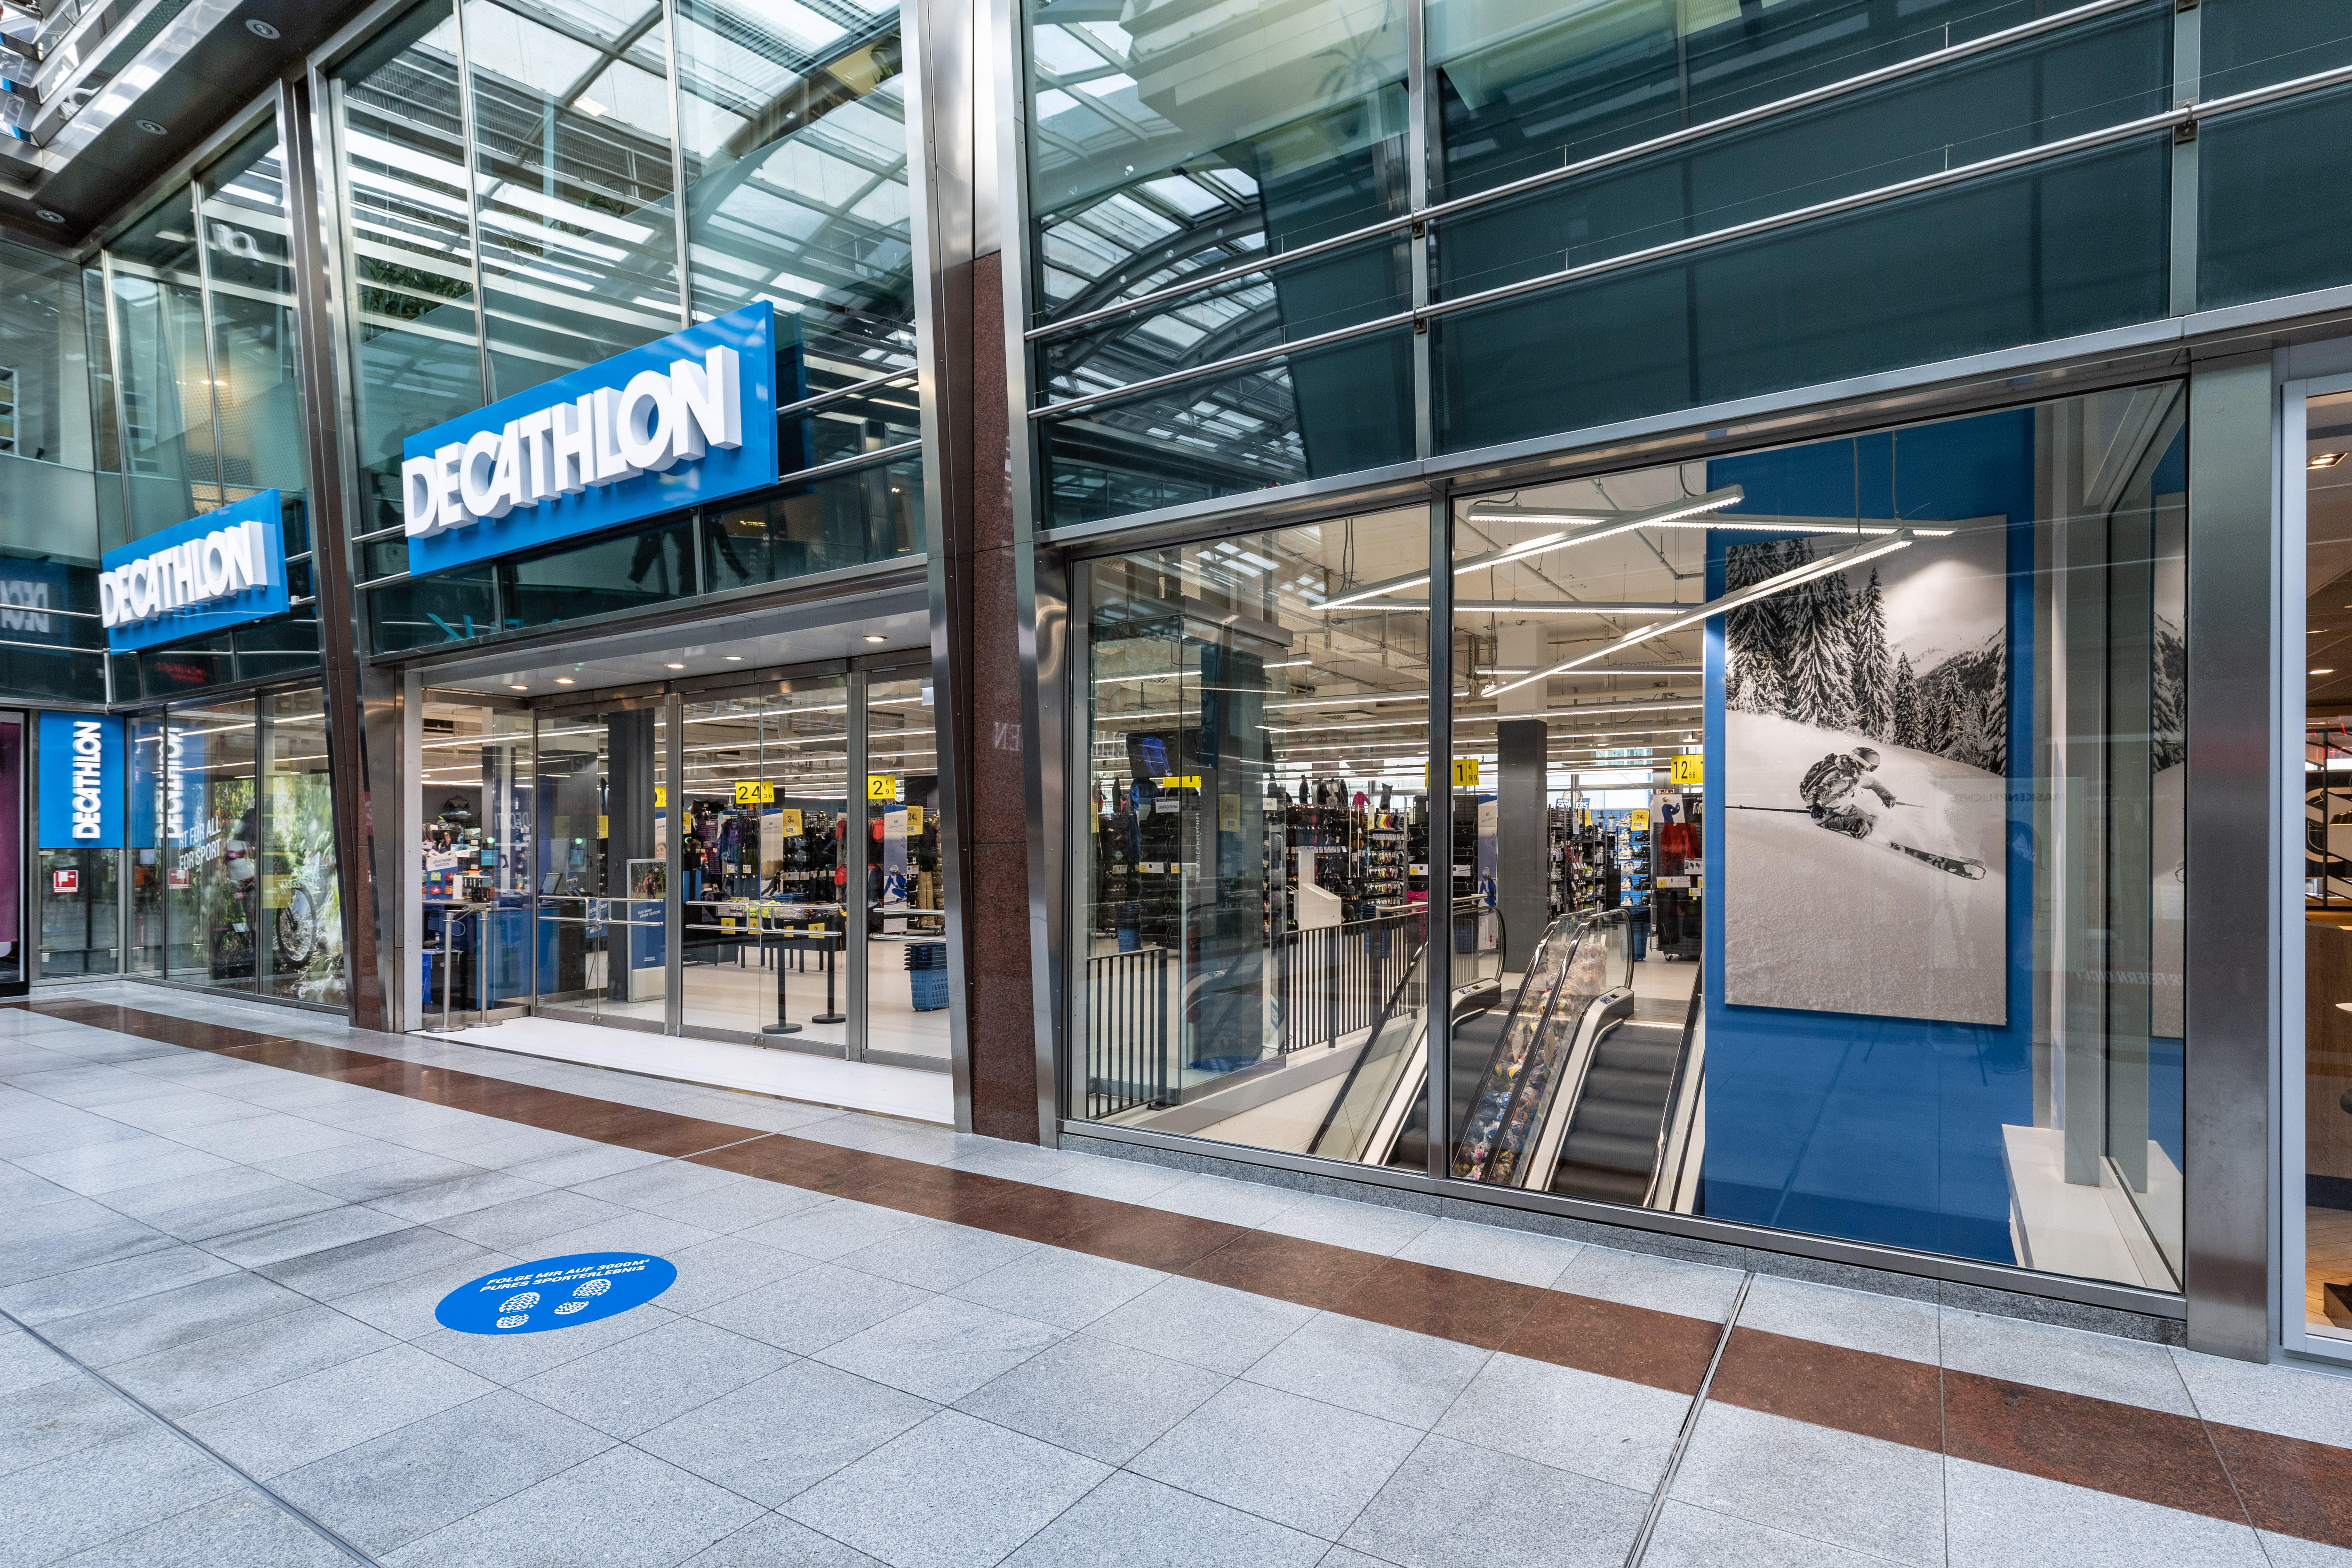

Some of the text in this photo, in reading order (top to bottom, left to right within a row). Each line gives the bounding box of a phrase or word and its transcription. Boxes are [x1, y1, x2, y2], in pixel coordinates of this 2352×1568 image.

[402, 345, 742, 539] DECATHLON
[99, 521, 267, 628] DECATHLON
[72, 721, 101, 839] DECATHLON
[1674, 761, 1688, 779] 12
[739, 785, 760, 800] 24
[189, 824, 204, 846] FOR
[206, 816, 221, 838] ALL
[179, 838, 221, 871] FOR SPORT
[479, 1265, 646, 1292] PURES SPORTERLEBNIS
[487, 1273, 534, 1285] FOLGE
[536, 1270, 563, 1278] MIR
[565, 1266, 595, 1275] AUF
